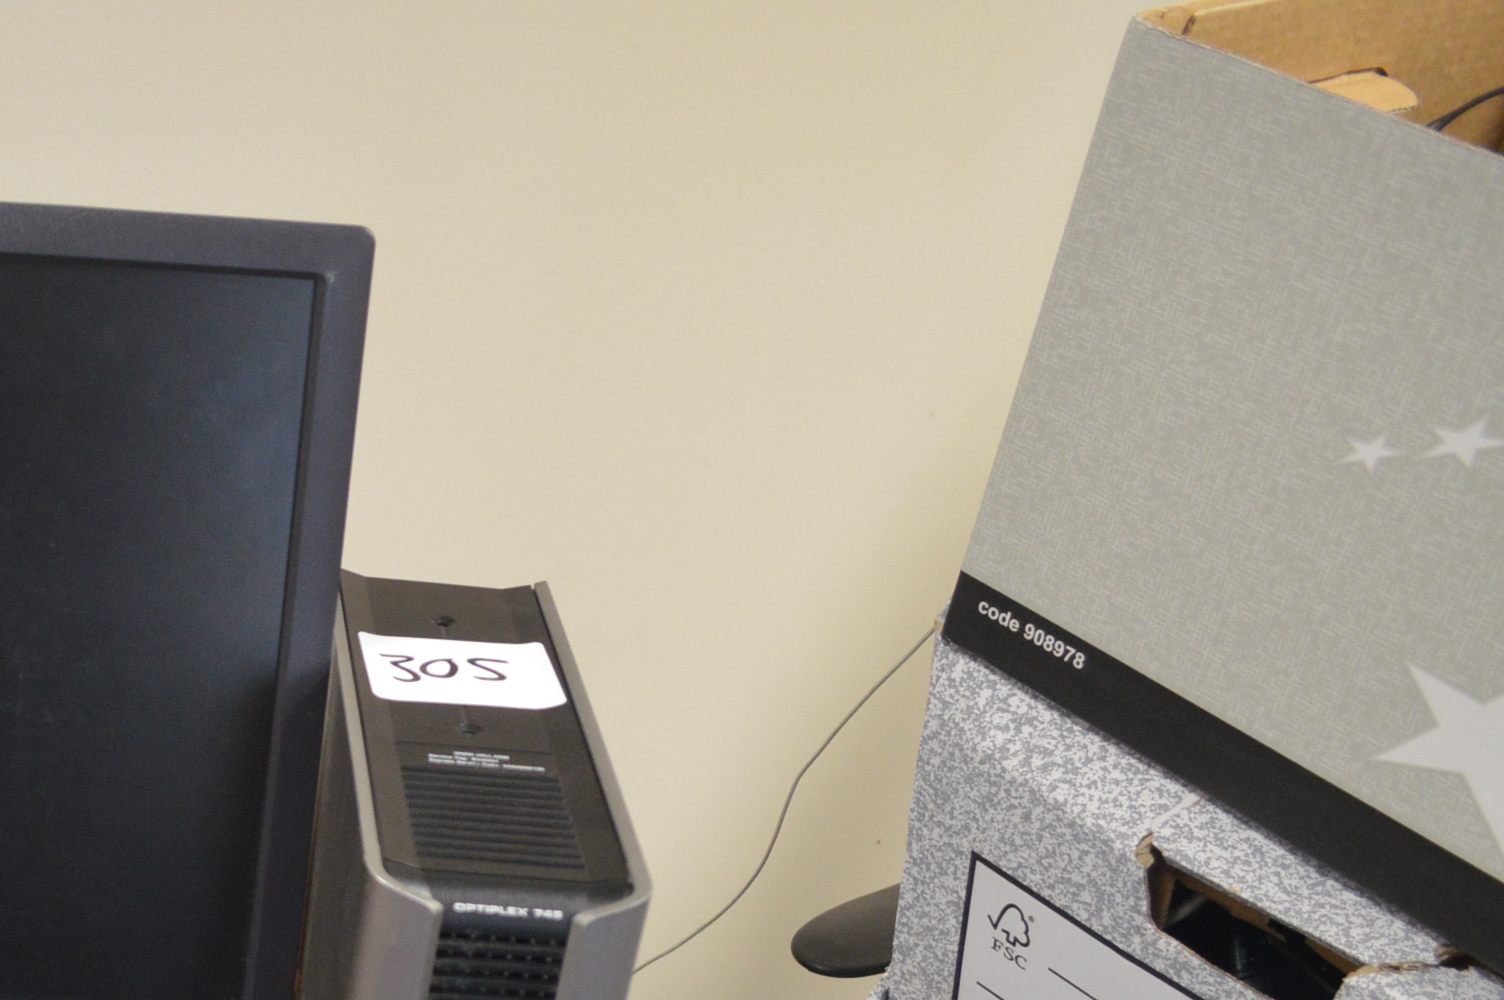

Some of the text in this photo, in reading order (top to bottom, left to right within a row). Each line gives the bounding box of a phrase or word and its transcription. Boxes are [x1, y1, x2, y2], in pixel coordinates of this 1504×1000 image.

[978, 601, 1085, 670] code 908978
[379, 652, 509, 682] 305
[453, 902, 529, 918] OPTIPLEX
[990, 936, 1027, 970] FSC
